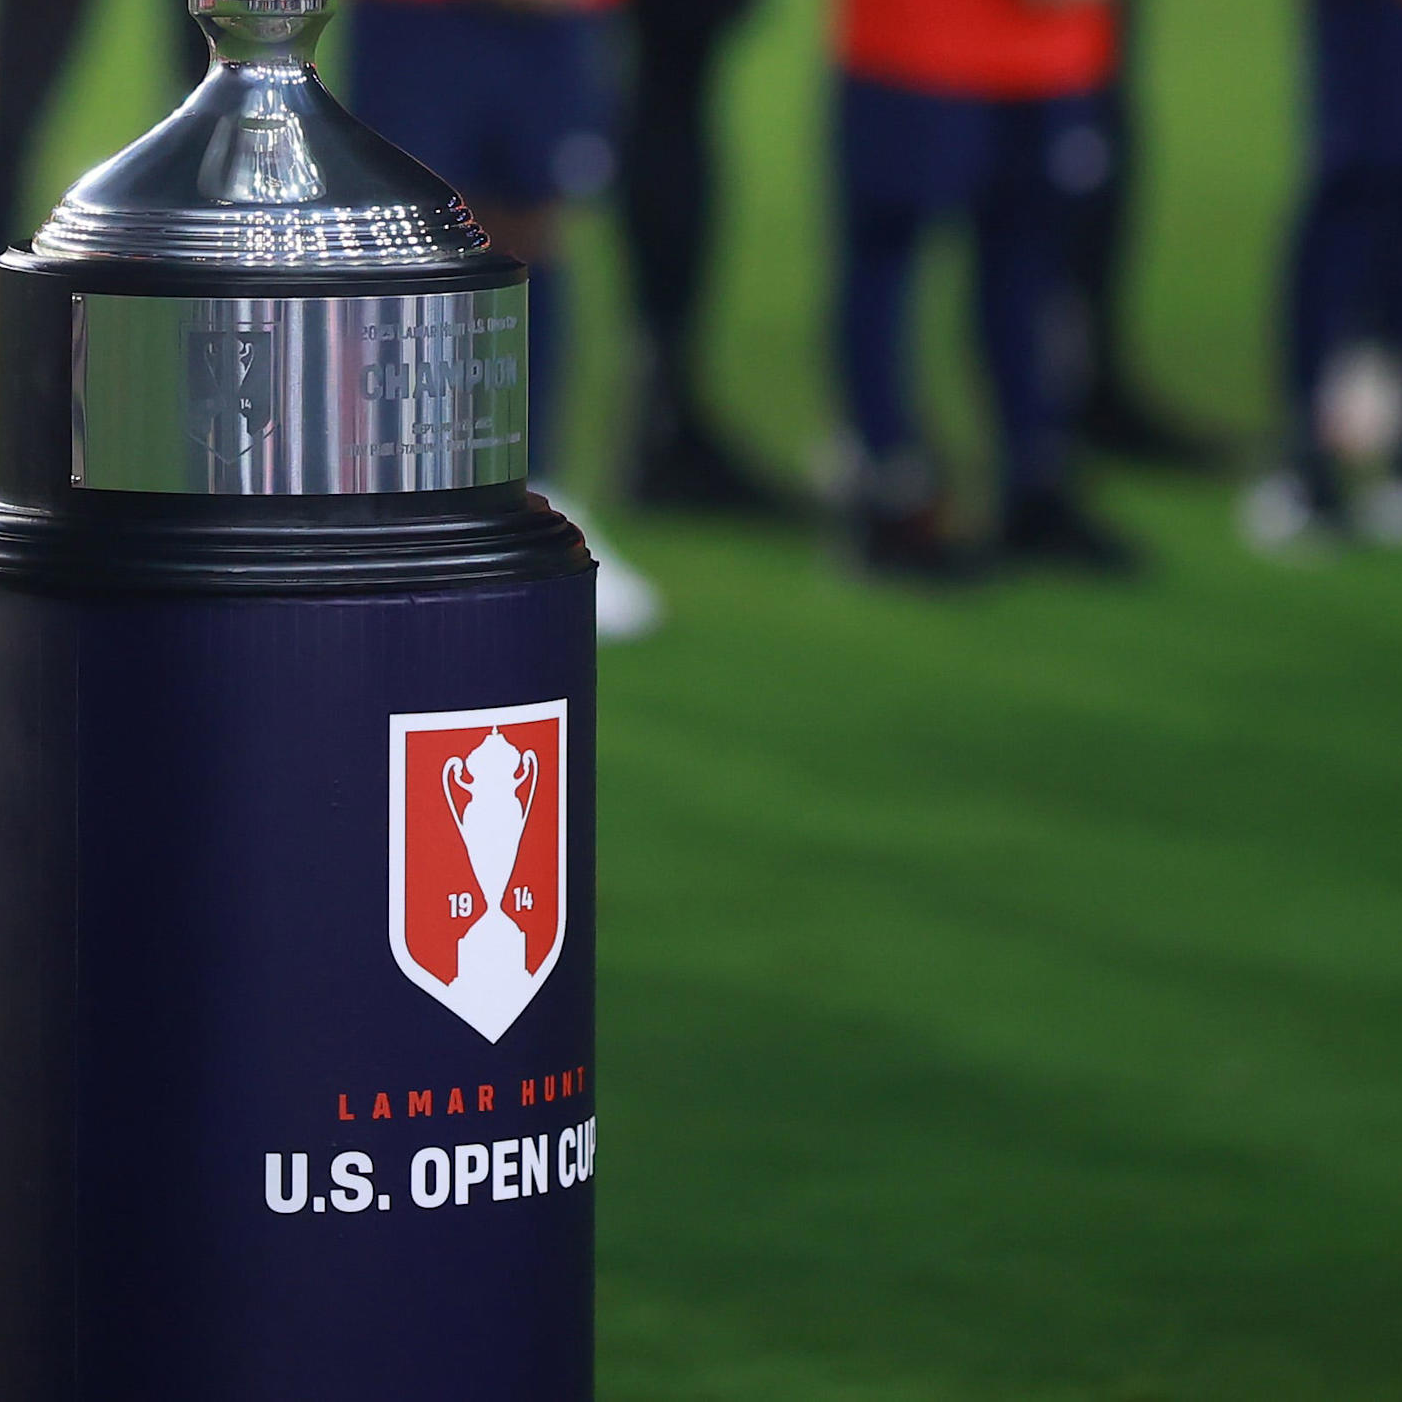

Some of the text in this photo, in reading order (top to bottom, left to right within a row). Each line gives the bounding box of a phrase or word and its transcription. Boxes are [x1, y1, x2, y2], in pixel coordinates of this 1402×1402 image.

[240, 398, 252, 409] 14
[448, 886, 534, 918] 19 14
[338, 1066, 586, 1121] LAMAR HUNT
[265, 1115, 596, 1214] U.S. OPEN CUP
